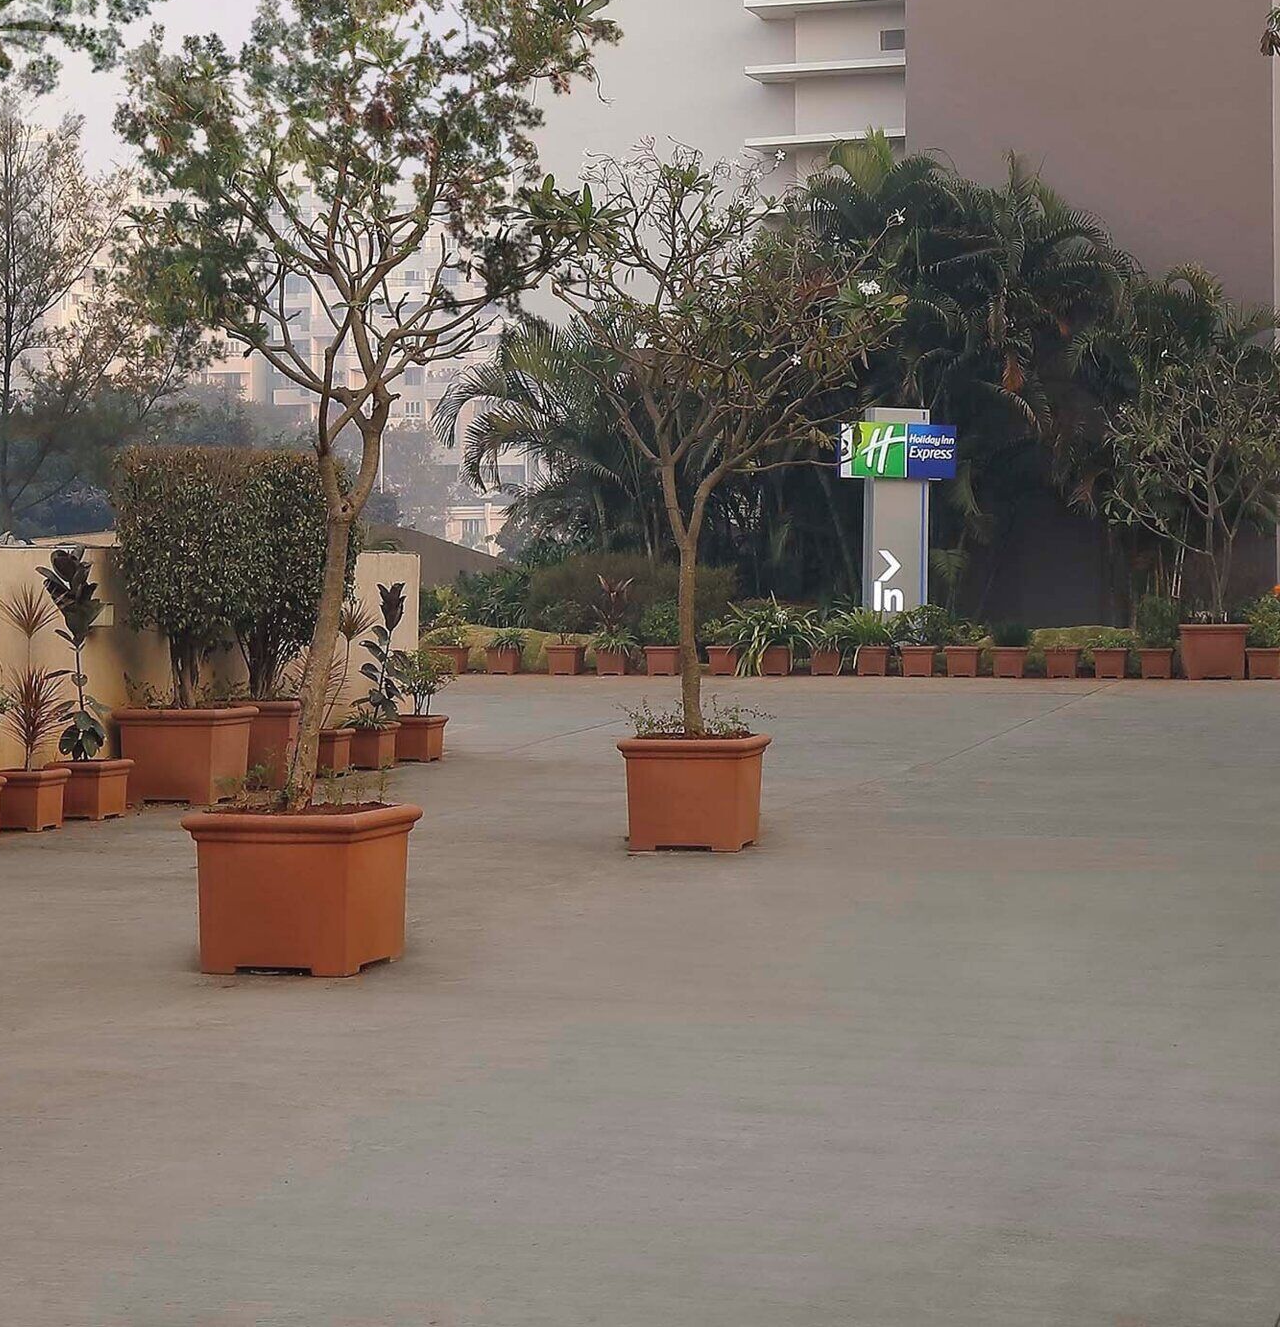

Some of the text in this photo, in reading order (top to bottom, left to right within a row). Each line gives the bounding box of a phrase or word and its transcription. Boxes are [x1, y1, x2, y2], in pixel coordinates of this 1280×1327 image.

[909, 433, 955, 447] Holiday Inn
[909, 445, 955, 462] Express
[873, 580, 904, 612] In
